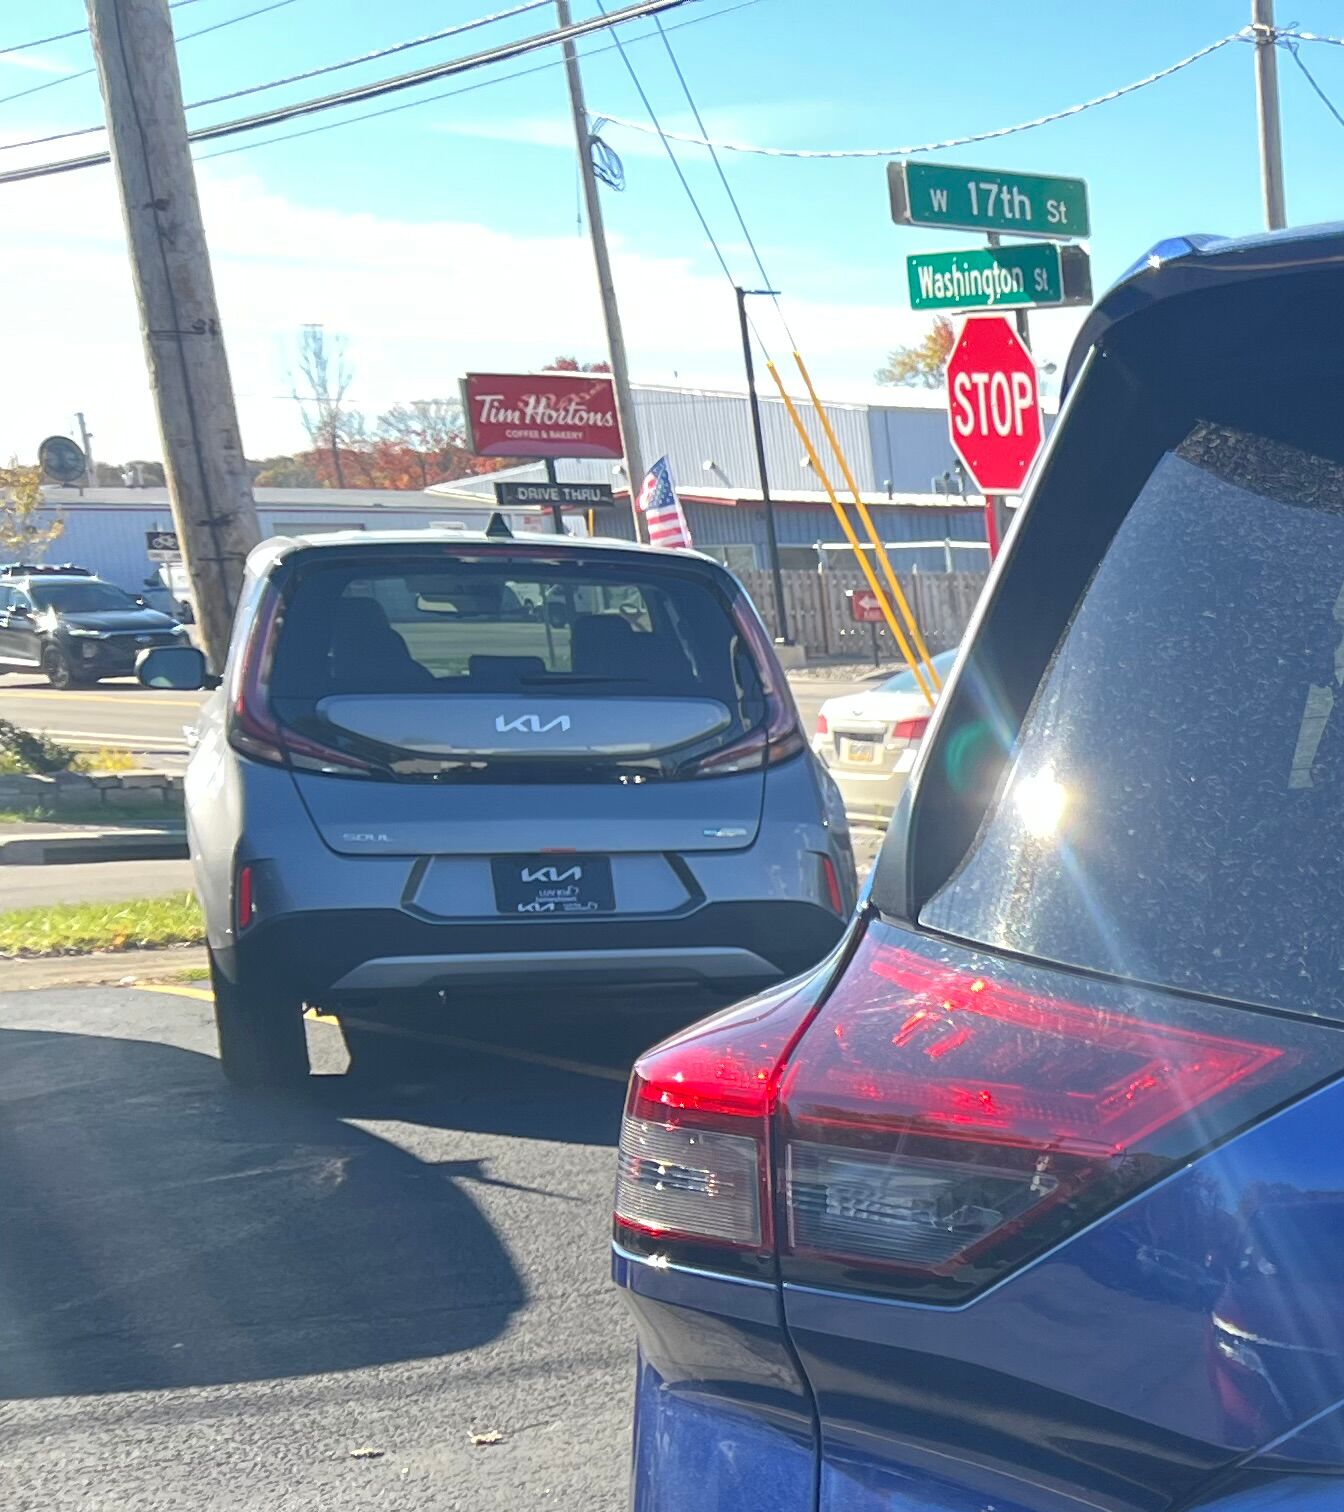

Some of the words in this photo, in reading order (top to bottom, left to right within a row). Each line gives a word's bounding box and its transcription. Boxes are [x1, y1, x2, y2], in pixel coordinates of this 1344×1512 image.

[929, 187, 948, 214] W
[967, 180, 1032, 221] 17th
[1046, 199, 1068, 225] St
[917, 261, 1025, 305] Washington
[1033, 267, 1049, 292] St
[475, 394, 520, 425] Tim
[524, 393, 615, 427] Hortons
[953, 371, 1034, 438] STOP
[505, 429, 539, 439] COFFEE
[549, 430, 584, 440] BAKERY
[517, 487, 560, 501] DRIVE
[562, 488, 601, 501] THRU
